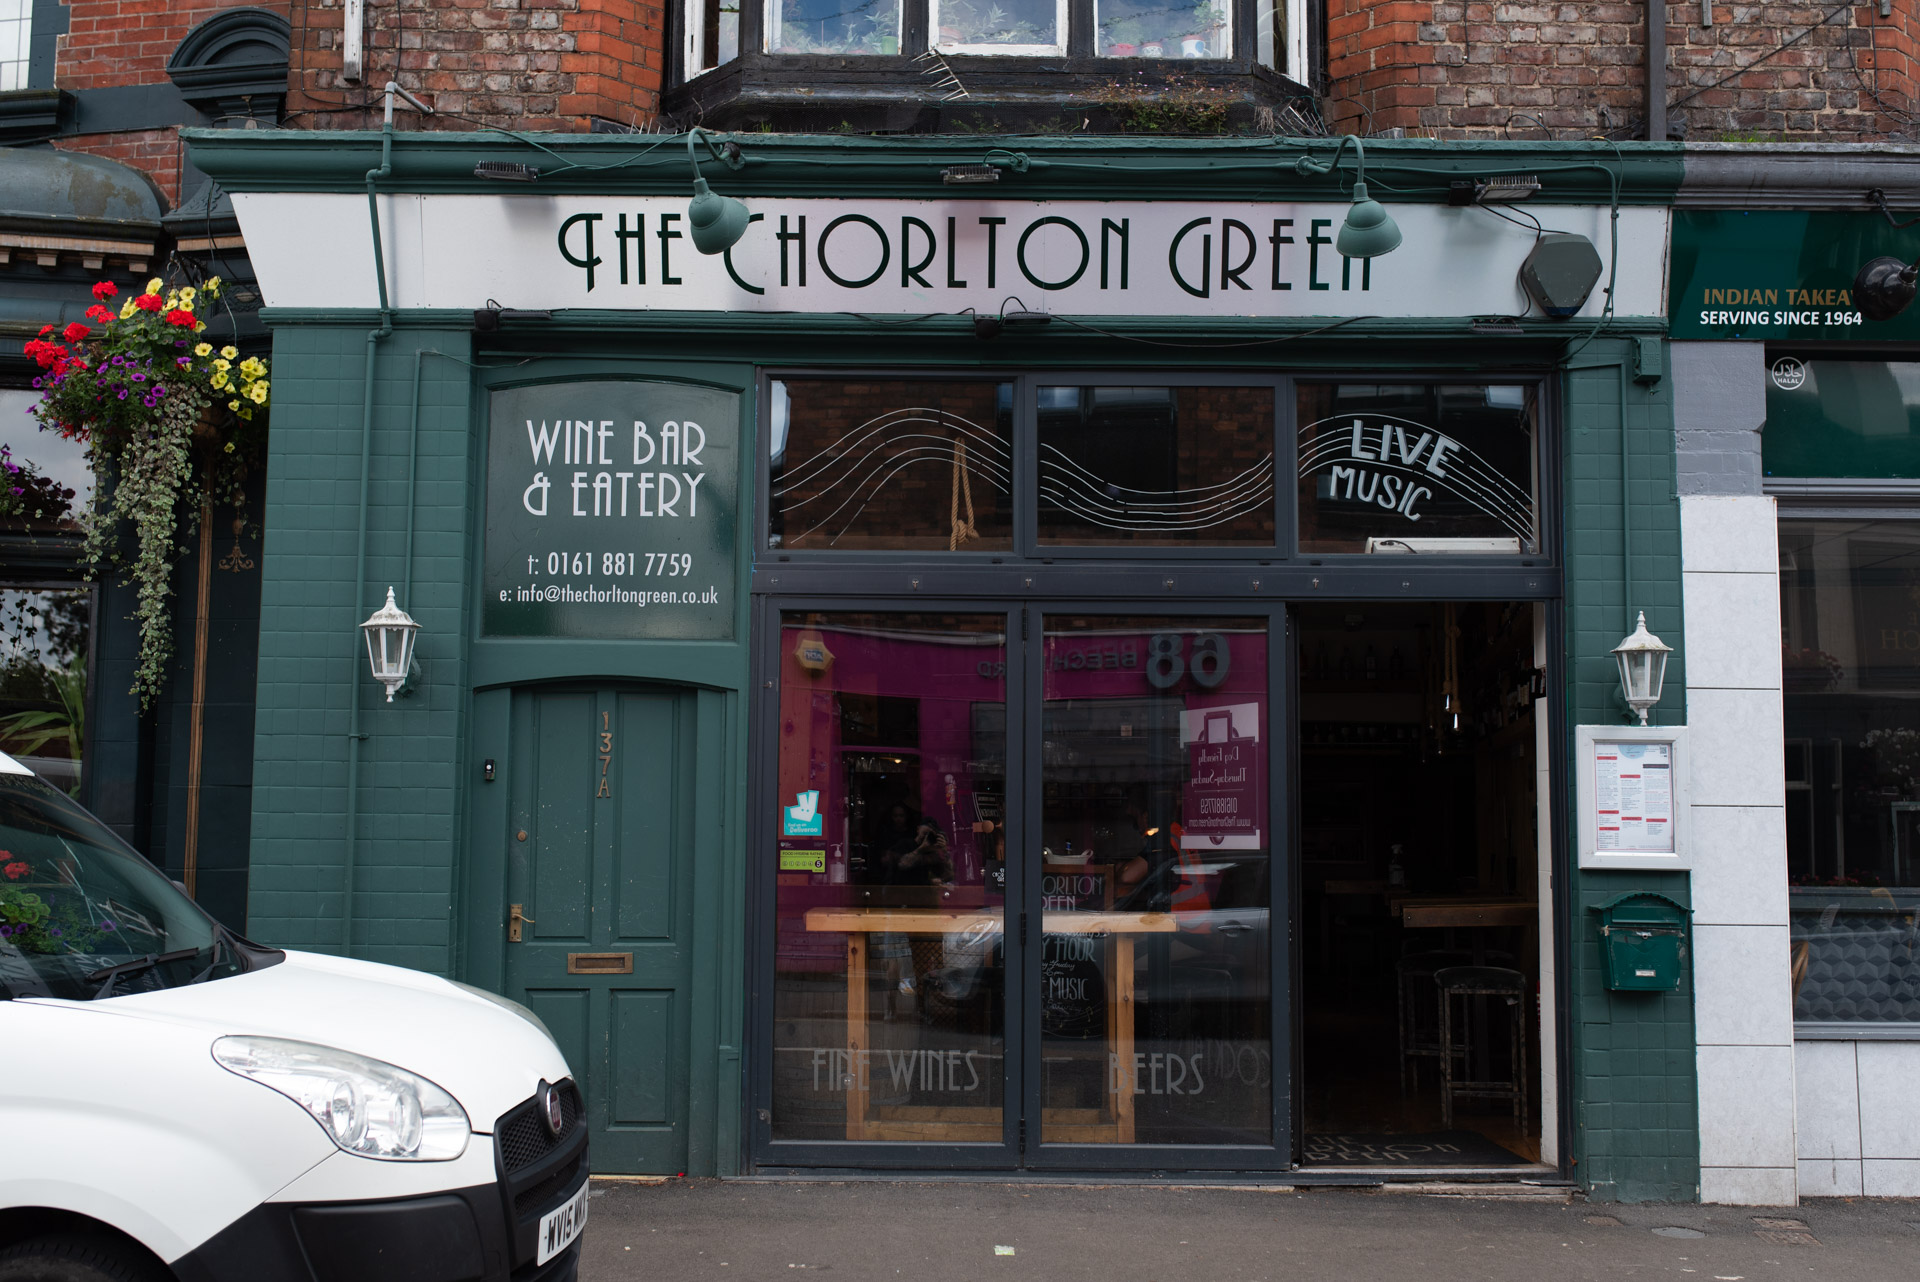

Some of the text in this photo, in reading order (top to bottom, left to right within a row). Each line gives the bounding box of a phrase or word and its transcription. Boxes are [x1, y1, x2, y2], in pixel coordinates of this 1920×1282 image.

[557, 212, 683, 294] THE
[723, 212, 1129, 295] CHORLTON
[1703, 288, 1853, 306] INDIAN TAKEA
[1700, 310, 1862, 326] SERVING SINCE 1964
[525, 419, 706, 466] WINE BAR
[1351, 419, 1461, 479] LIVE
[523, 471, 706, 517] & EATERY
[1329, 465, 1432, 522] MUSIC
[528, 552, 692, 577] t: 0161 881 7759
[499, 583, 718, 608] e: info@thechorltongreen.co.uk
[597, 711, 613, 798] 137A
[1042, 875, 1102, 895] ORLTON
[1055, 937, 1096, 962] HOUR
[1049, 977, 1089, 1000] MUSIC
[811, 1048, 1205, 1095] FINE WINES BEERS
